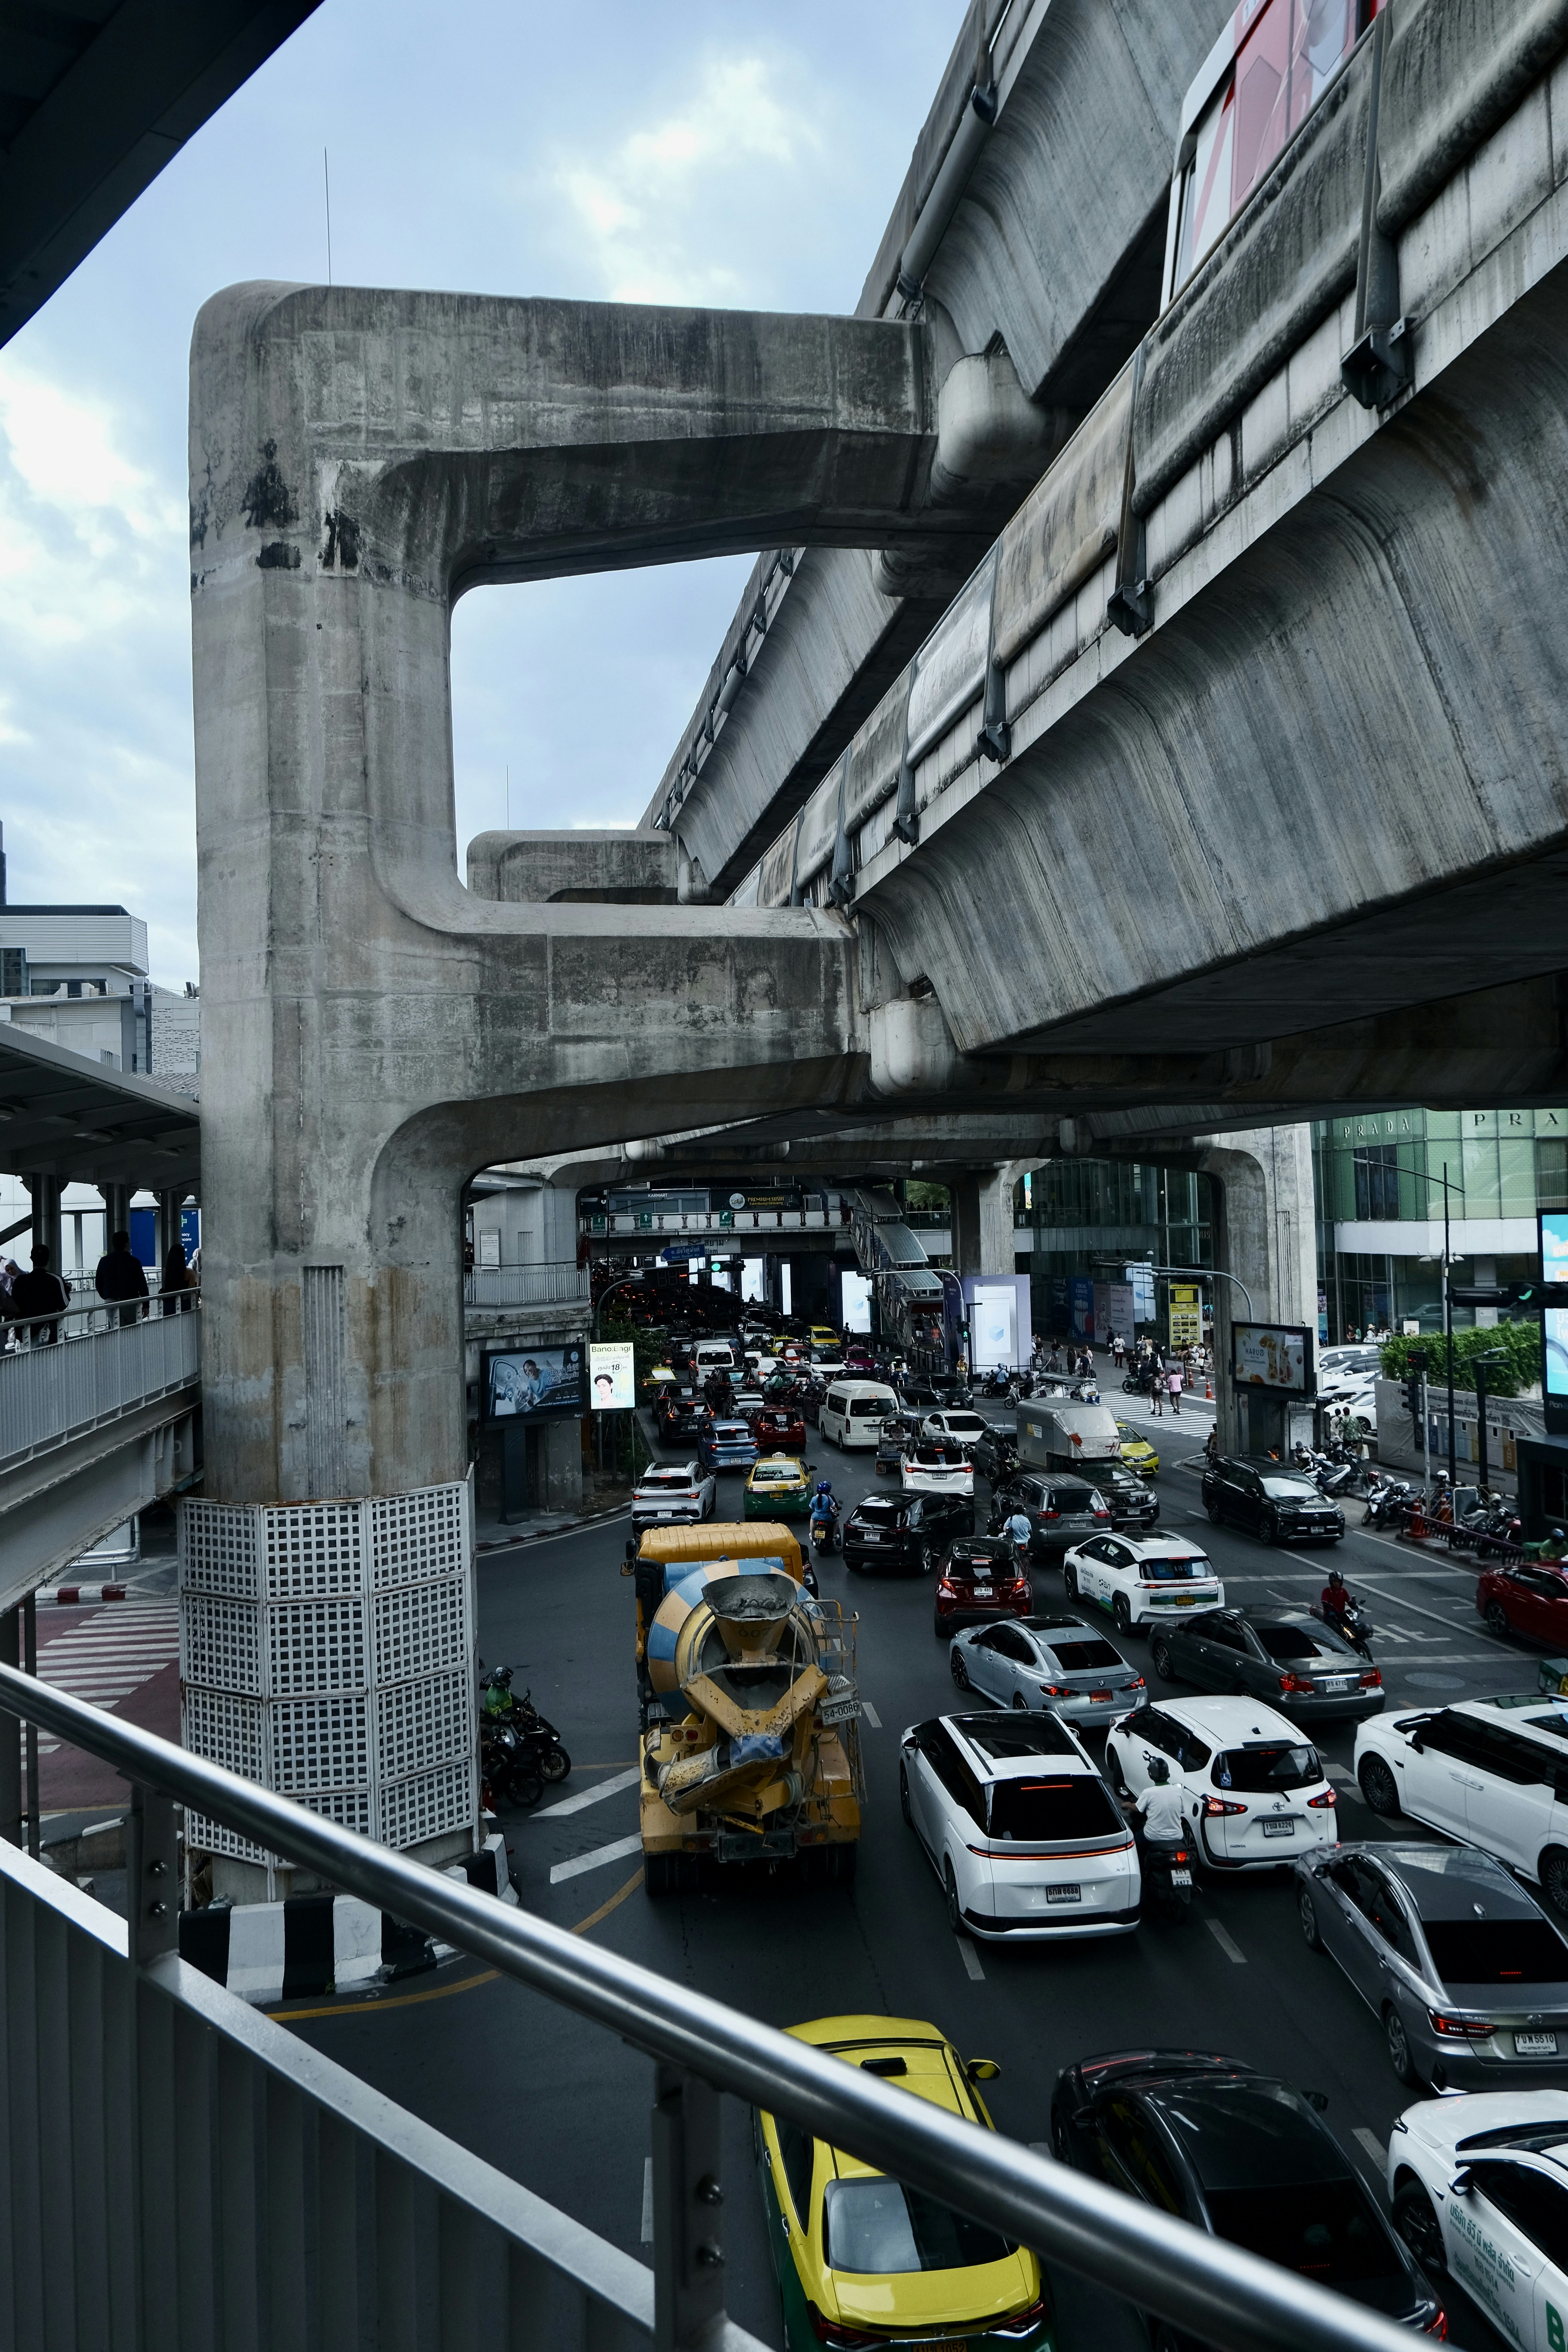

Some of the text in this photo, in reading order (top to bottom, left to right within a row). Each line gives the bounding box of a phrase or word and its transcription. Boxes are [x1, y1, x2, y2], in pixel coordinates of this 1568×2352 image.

[1343, 1118, 1409, 1138] PRADA
[824, 1703, 859, 1719] 54-0086
[1534, 2035, 1554, 2043] 5510
[1450, 2203, 1466, 2230] บริษัท
[1483, 2238, 1496, 2263] พลัส
[1498, 2252, 1514, 2283] จำกัด
[1462, 2233, 1472, 2247] PLUS
[1473, 2244, 1495, 2271] COMPANY
[1496, 2268, 1515, 2293] LIMITED
[1485, 2267, 1499, 2292] 1514
[940, 2343, 965, 2352] 1052
